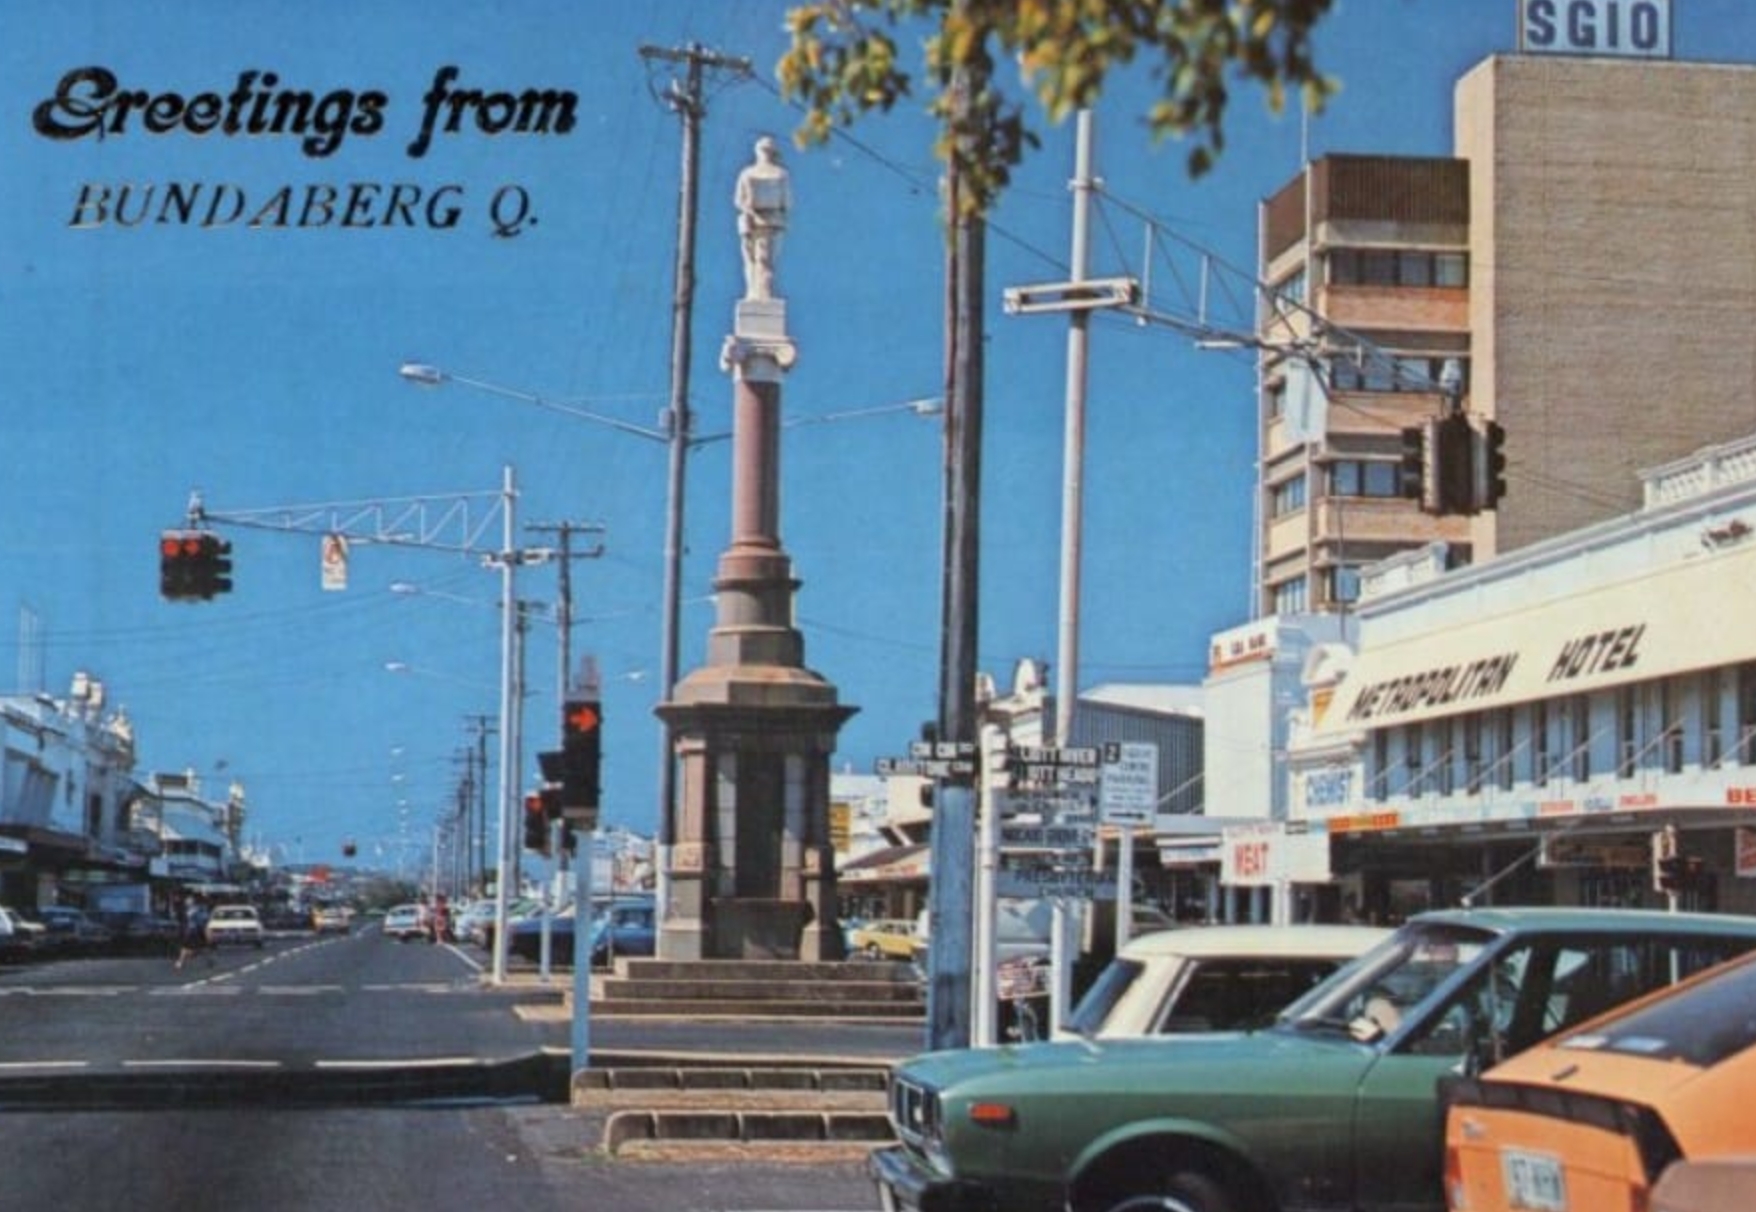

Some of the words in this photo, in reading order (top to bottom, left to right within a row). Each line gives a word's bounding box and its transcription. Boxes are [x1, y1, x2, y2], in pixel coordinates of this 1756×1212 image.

[1526, 0, 1658, 50] SGIO
[1346, 652, 1520, 721] METROPOLITAN
[1547, 623, 1647, 682] HOTEL
